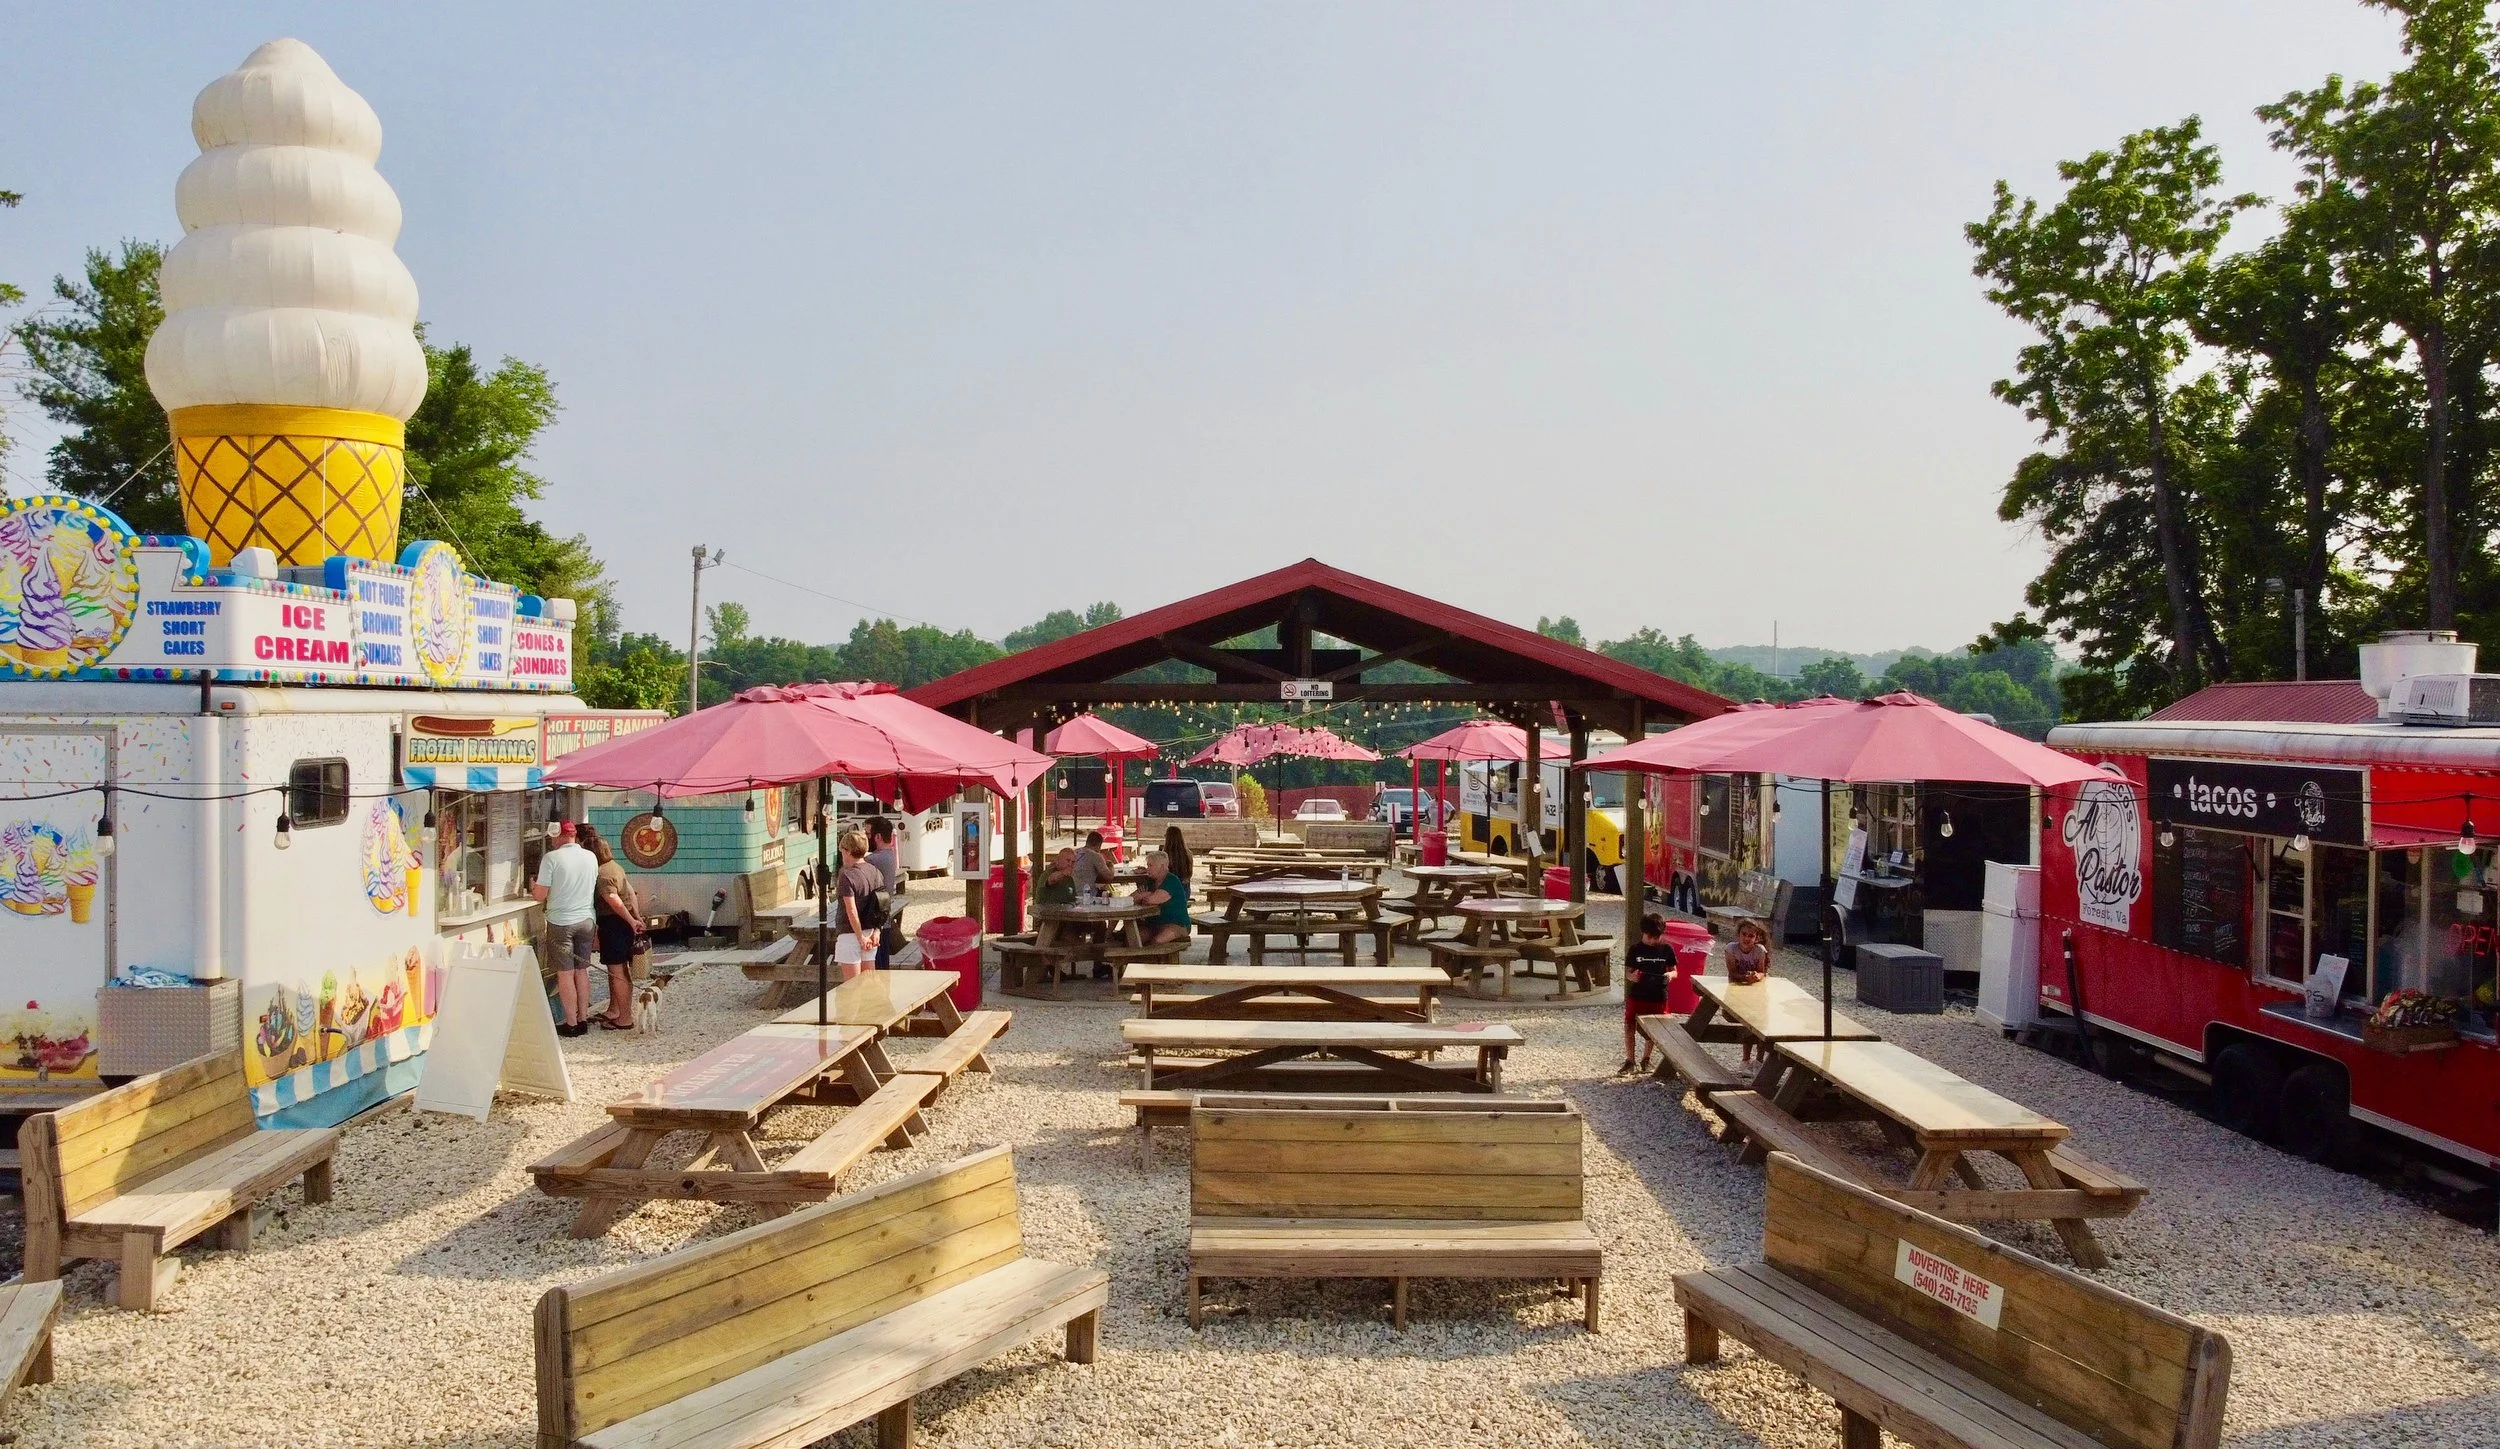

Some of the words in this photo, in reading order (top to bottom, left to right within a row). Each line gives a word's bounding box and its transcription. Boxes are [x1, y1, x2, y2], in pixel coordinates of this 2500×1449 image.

[359, 580, 379, 602] HOT
[379, 583, 405, 607] FUDGE
[146, 601, 221, 615] STRAWBERRY
[281, 604, 326, 631] ICE
[162, 620, 206, 635] SHORT
[362, 611, 402, 637] BROWNIE
[477, 625, 502, 645] SHORT
[163, 640, 205, 655] CAKES
[254, 635, 350, 664] CREAM
[363, 641, 402, 666] SUNDAES
[517, 631, 554, 650] CONES
[556, 637, 565, 652] &
[478, 652, 502, 671] CAKES
[515, 655, 567, 676] SUNDAES
[547, 719, 572, 733] HOT
[574, 719, 610, 732] FUDGE
[409, 738, 464, 763] FROZEN
[467, 738, 536, 764] BANANAS
[2188, 776, 2258, 818] tacos
[2065, 797, 2100, 844] Al
[2078, 848, 2140, 899] Pastor
[2082, 903, 2113, 922] Forest,
[2116, 911, 2127, 924] Va
[1908, 1249, 1959, 1286] ADVERTISE
[1962, 1274, 1990, 1301] HERE
[1913, 1270, 1938, 1297] (540)
[1938, 1283, 1979, 1316] 251-7135
